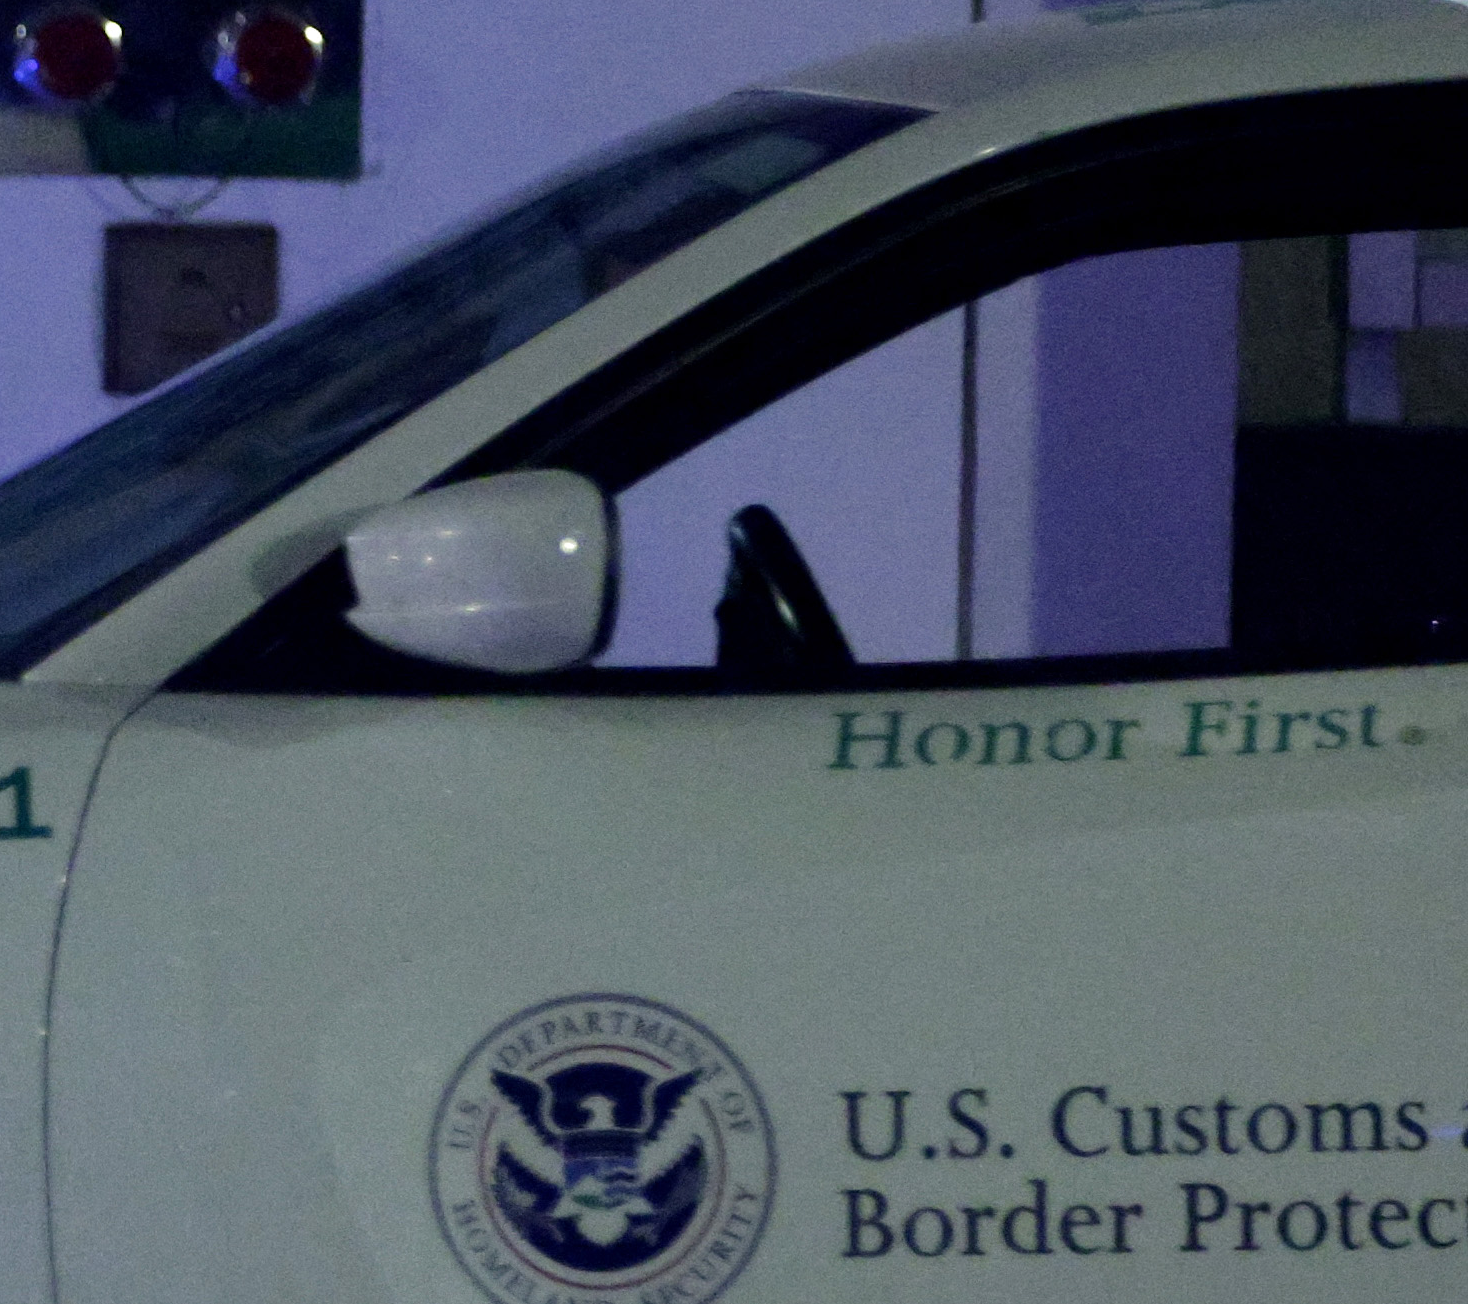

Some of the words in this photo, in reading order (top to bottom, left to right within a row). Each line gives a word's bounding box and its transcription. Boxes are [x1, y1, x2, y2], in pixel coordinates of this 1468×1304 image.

[826, 709, 1142, 770] Honor
[495, 1011, 723, 1083] DEPARTMENT
[721, 1091, 755, 1135] OF
[838, 1087, 1015, 1162] U.S.
[1050, 1085, 1430, 1158] Customs
[839, 1178, 1144, 1258] Border
[1179, 1180, 1468, 1252] Protec
